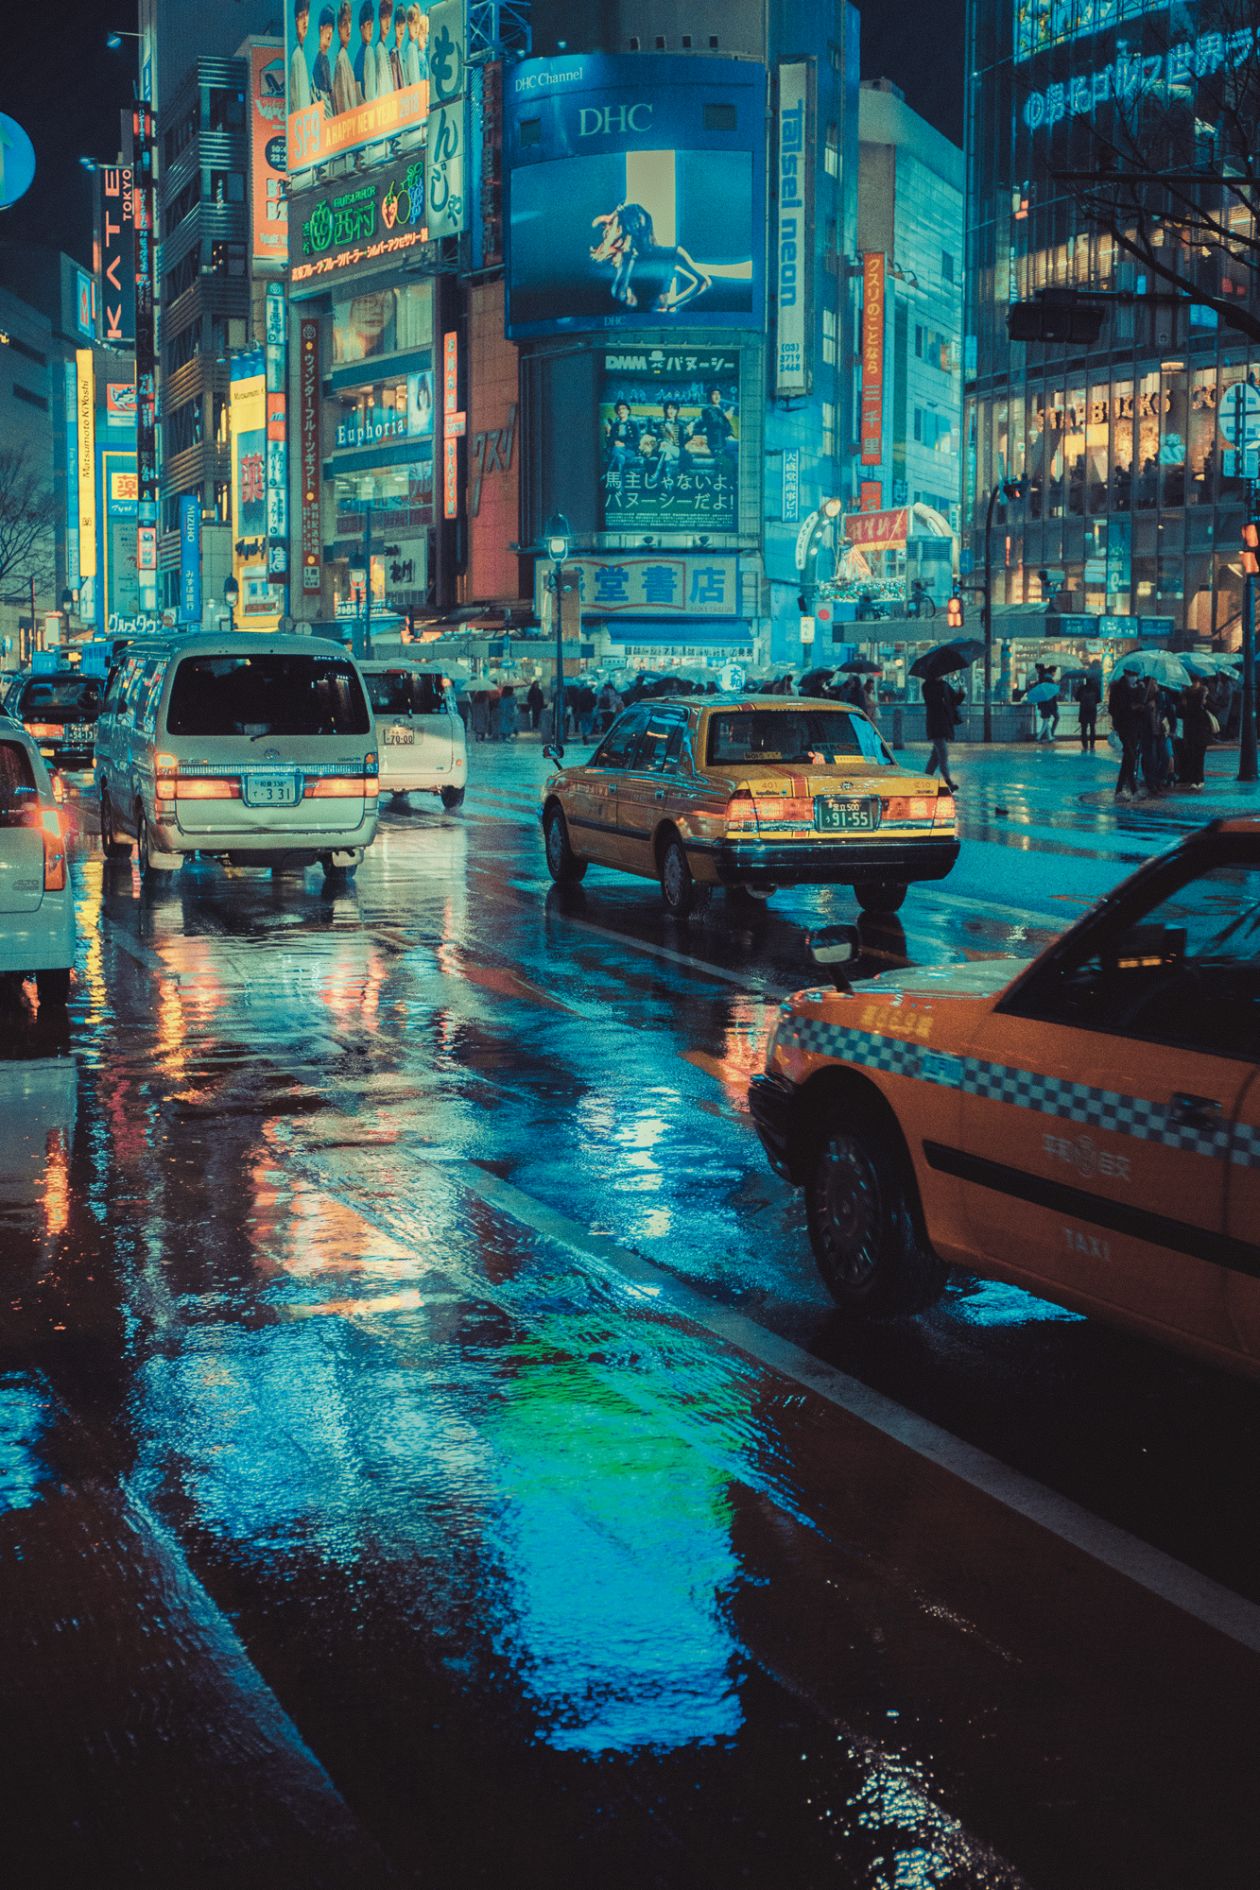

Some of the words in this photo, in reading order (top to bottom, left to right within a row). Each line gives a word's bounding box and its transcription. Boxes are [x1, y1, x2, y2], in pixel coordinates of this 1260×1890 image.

[515, 76, 537, 92] DHC
[537, 67, 584, 87] Channel
[294, 110, 320, 160] SF9
[431, 25, 465, 227] もんじゃ
[579, 103, 653, 137] DHC
[122, 169, 132, 221] TOKYO
[333, 200, 377, 246] 西村
[780, 218, 797, 307] neon
[604, 316, 626, 327] DHC
[605, 355, 647, 370] DMM
[666, 356, 735, 371] バヌーシー
[781, 342, 800, 352] (03)
[303, 354, 317, 491] ウィンターフルーツギフト
[338, 418, 405, 446] Euphoria
[863, 382, 881, 456] 三千里
[83, 419, 91, 479] Matsumoto
[605, 471, 734, 490] 馬主じゃないよ、
[187, 504, 195, 543] MIZUHO
[831, 811, 869, 826] 91-55
[847, 803, 861, 811] 500
